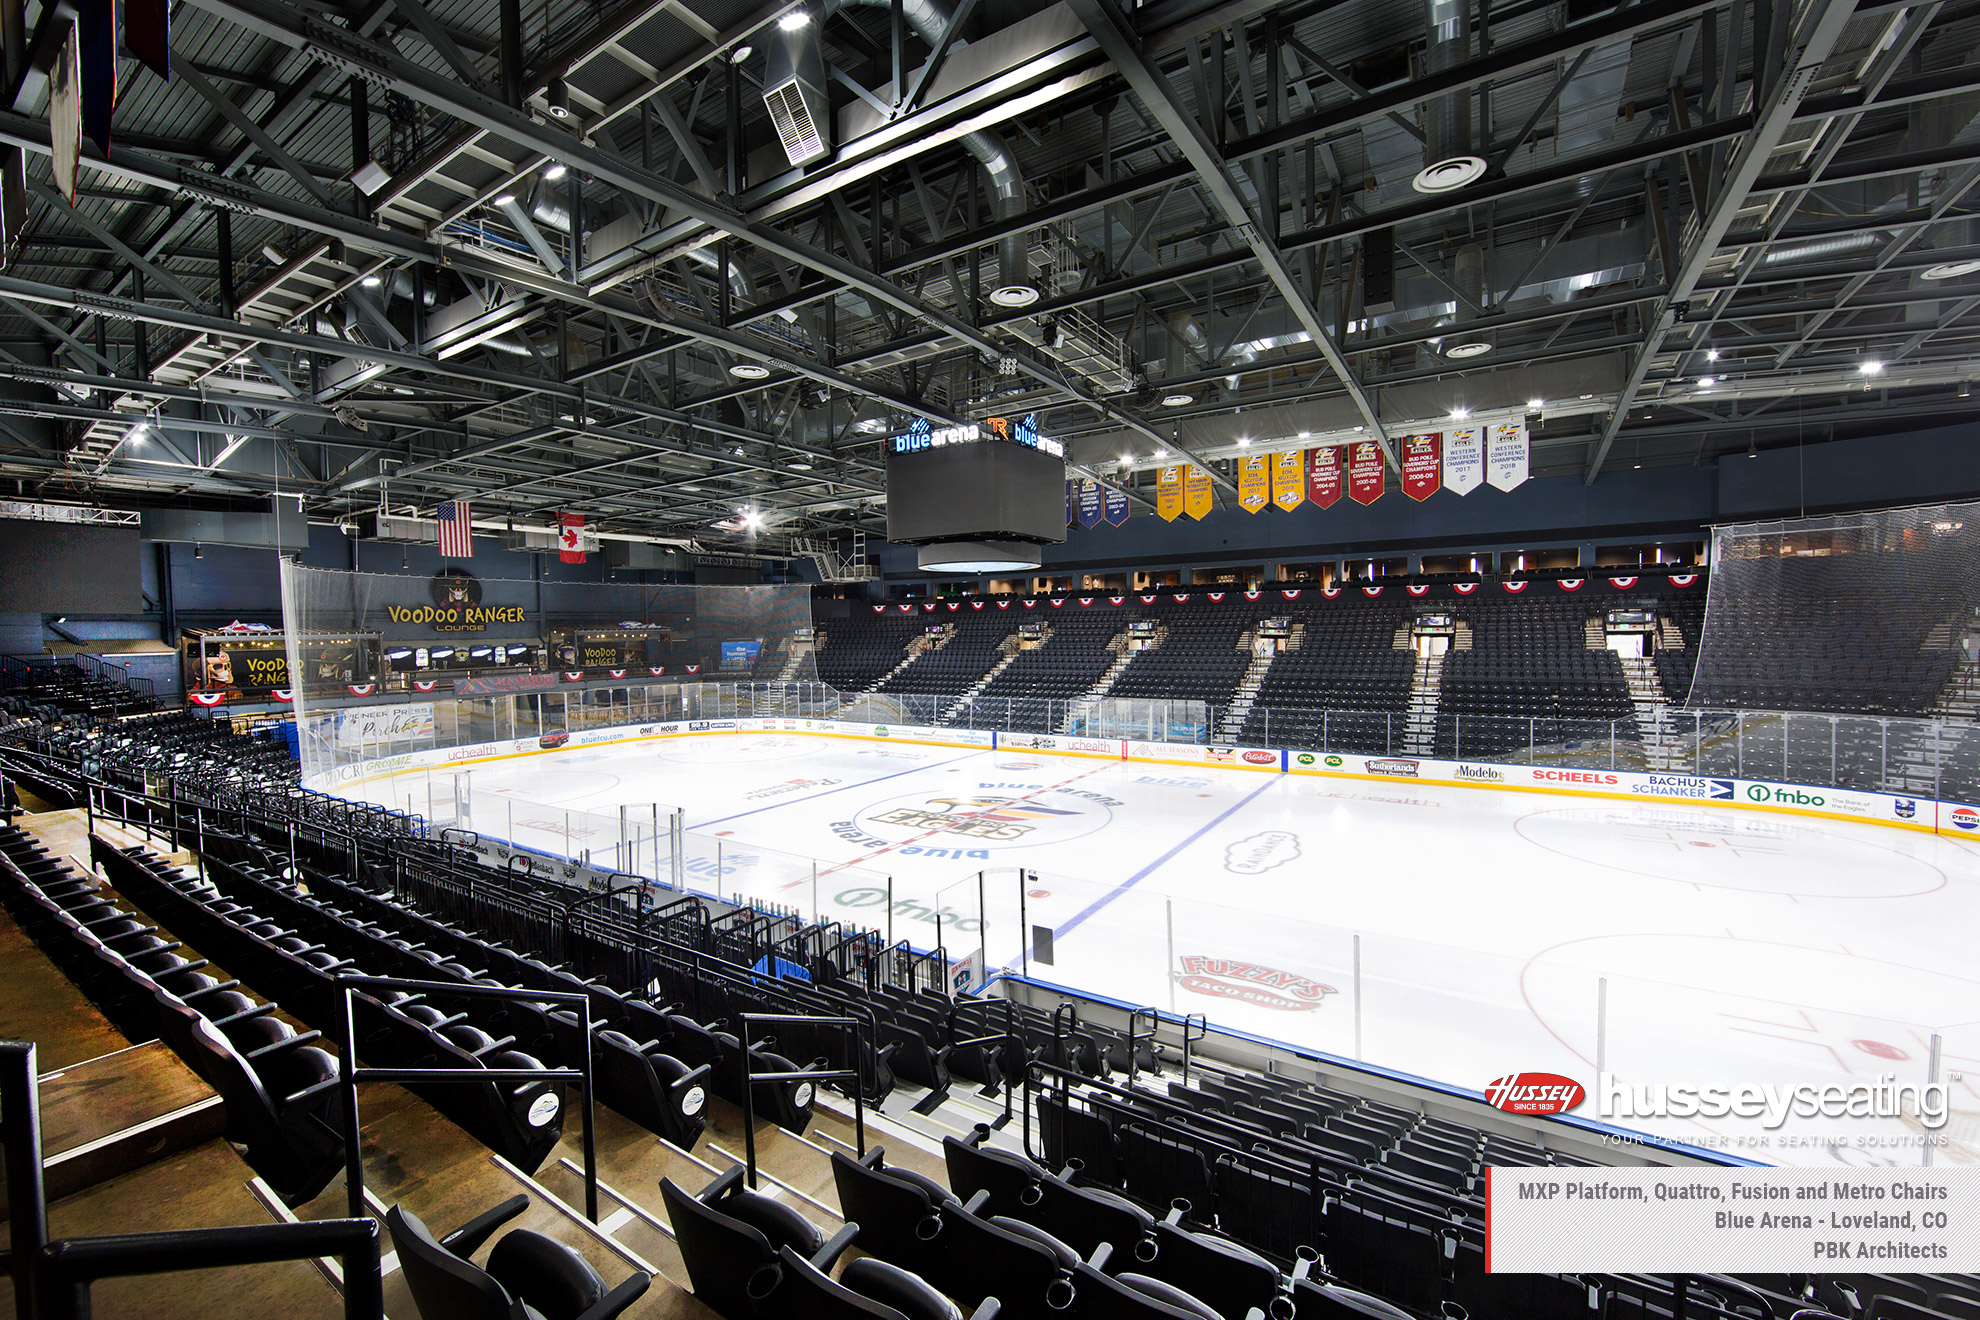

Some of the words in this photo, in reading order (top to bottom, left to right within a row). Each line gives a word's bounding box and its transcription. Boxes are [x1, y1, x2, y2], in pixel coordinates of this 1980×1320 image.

[896, 433, 930, 452] blue
[930, 424, 980, 446] arena
[1014, 423, 1036, 447] blue
[1036, 436, 1063, 457] arena
[1490, 450, 1526, 458] CONFERENCE
[1495, 444, 1522, 452] WESTERN
[1446, 453, 1480, 461] CONFERENCE
[1491, 456, 1526, 464] CHAMPIONS
[388, 605, 458, 624] VOODOO
[466, 606, 525, 624] RANGER
[585, 648, 616, 657] VOODOO
[496, 678, 512, 686] ALL
[515, 675, 555, 684] SEASONS
[581, 732, 624, 744] bluefcu.com
[447, 744, 497, 760] uchealth
[1068, 739, 1111, 753] uchealth
[1245, 752, 1275, 762] Peterbilt
[1369, 760, 1416, 772] Sutherlands
[1460, 765, 1498, 778] Modelo
[1134, 776, 1208, 788] blue
[1532, 770, 1618, 784] SCHEELS
[1650, 776, 1706, 788] BACHUS
[1632, 784, 1706, 797] SCHANKER
[1774, 788, 1825, 806] fnbo
[1056, 787, 1124, 808] arena
[1317, 790, 1440, 807] uchealth
[1845, 805, 1866, 813] Eagles
[867, 808, 1036, 840] EAGLES
[1952, 814, 1980, 823] PEPSI
[829, 821, 888, 848] arena
[899, 846, 990, 860] blue
[882, 898, 990, 932] fnbo
[1180, 956, 1338, 1001] FUZZY'S
[1188, 979, 1240, 996] TACO
[1242, 992, 1302, 1008] SHOP
